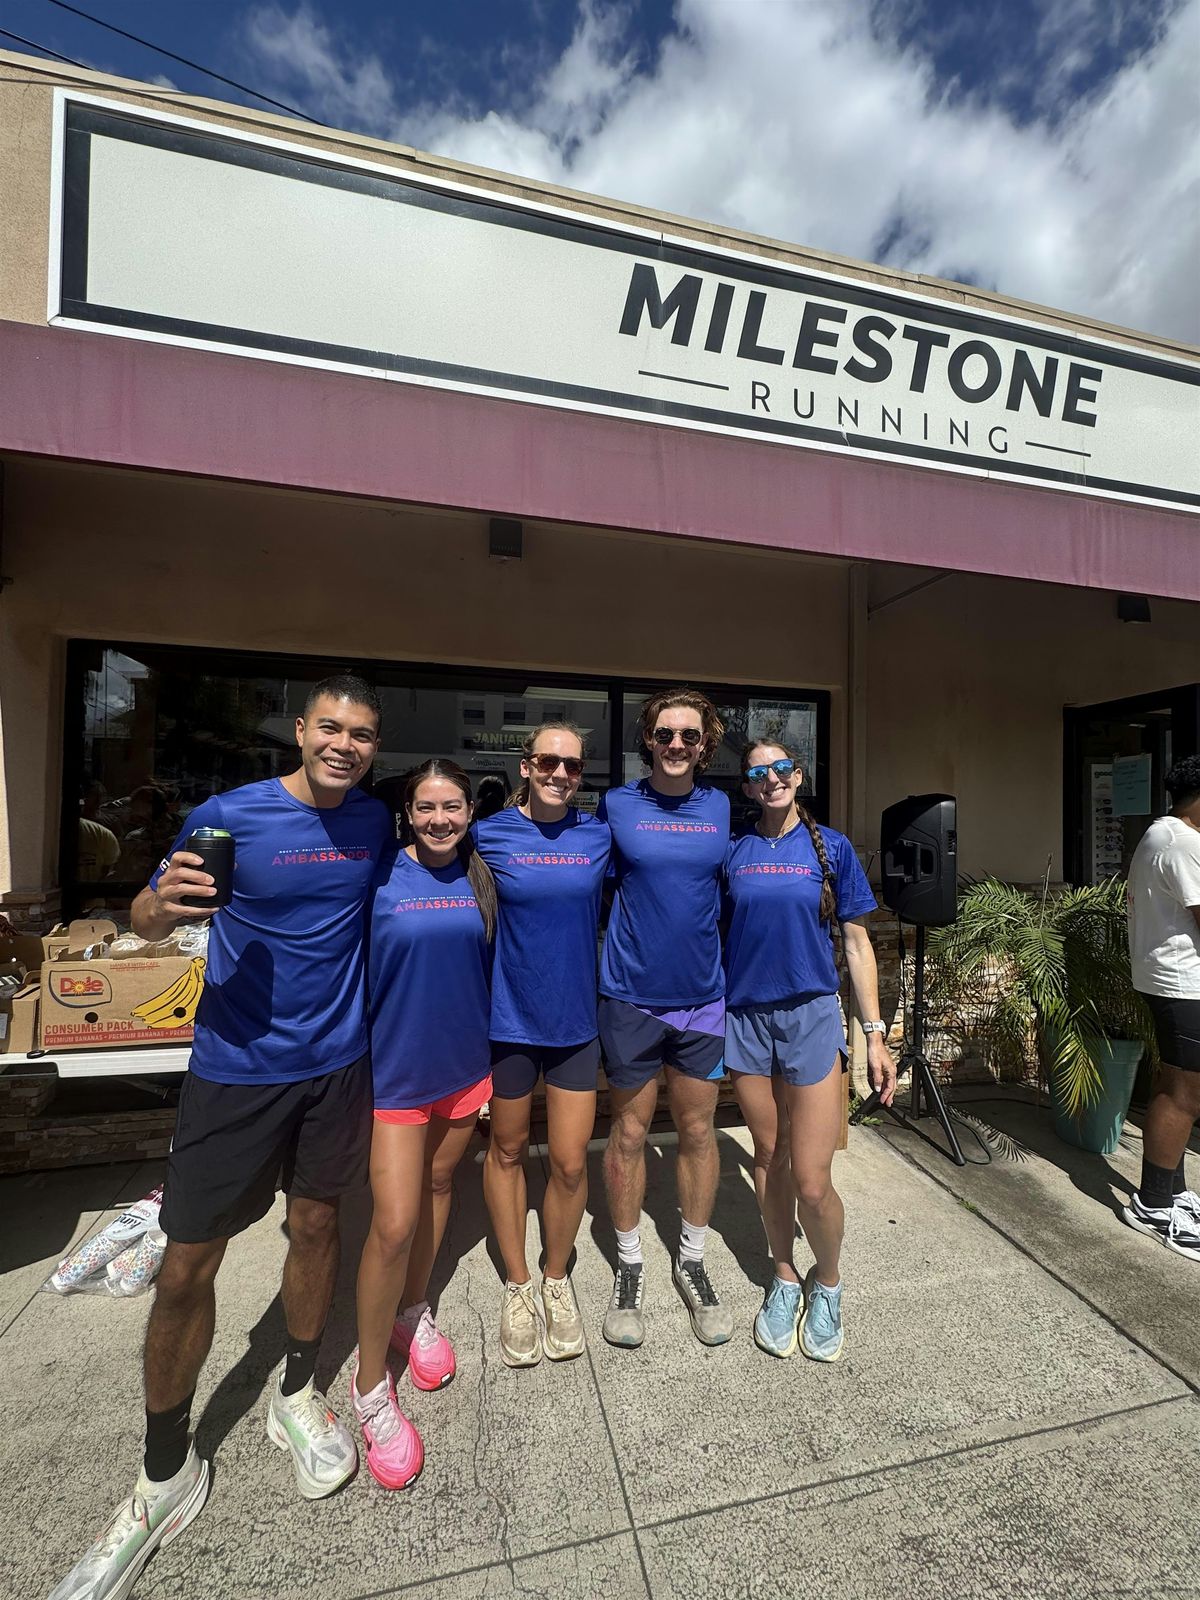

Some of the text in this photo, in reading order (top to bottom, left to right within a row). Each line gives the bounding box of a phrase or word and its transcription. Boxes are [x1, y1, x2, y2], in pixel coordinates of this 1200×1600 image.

[618, 262, 1103, 428] MILESTONE
[750, 380, 1009, 454] RUNNING
[472, 731, 525, 746] JANUAR
[635, 823, 718, 833] AMBASSADOR
[271, 850, 370, 866] AMBASSADOR
[507, 855, 591, 865] AMBASSADOR
[735, 865, 812, 876] AMBASSADOR
[395, 899, 479, 913] AMBASSADO
[60, 976, 104, 993] Dole
[45, 1021, 135, 1035] CONSUMER PACK
[74, 1034, 103, 1042] BANANAS
[108, 1032, 137, 1040] PREMIUM
